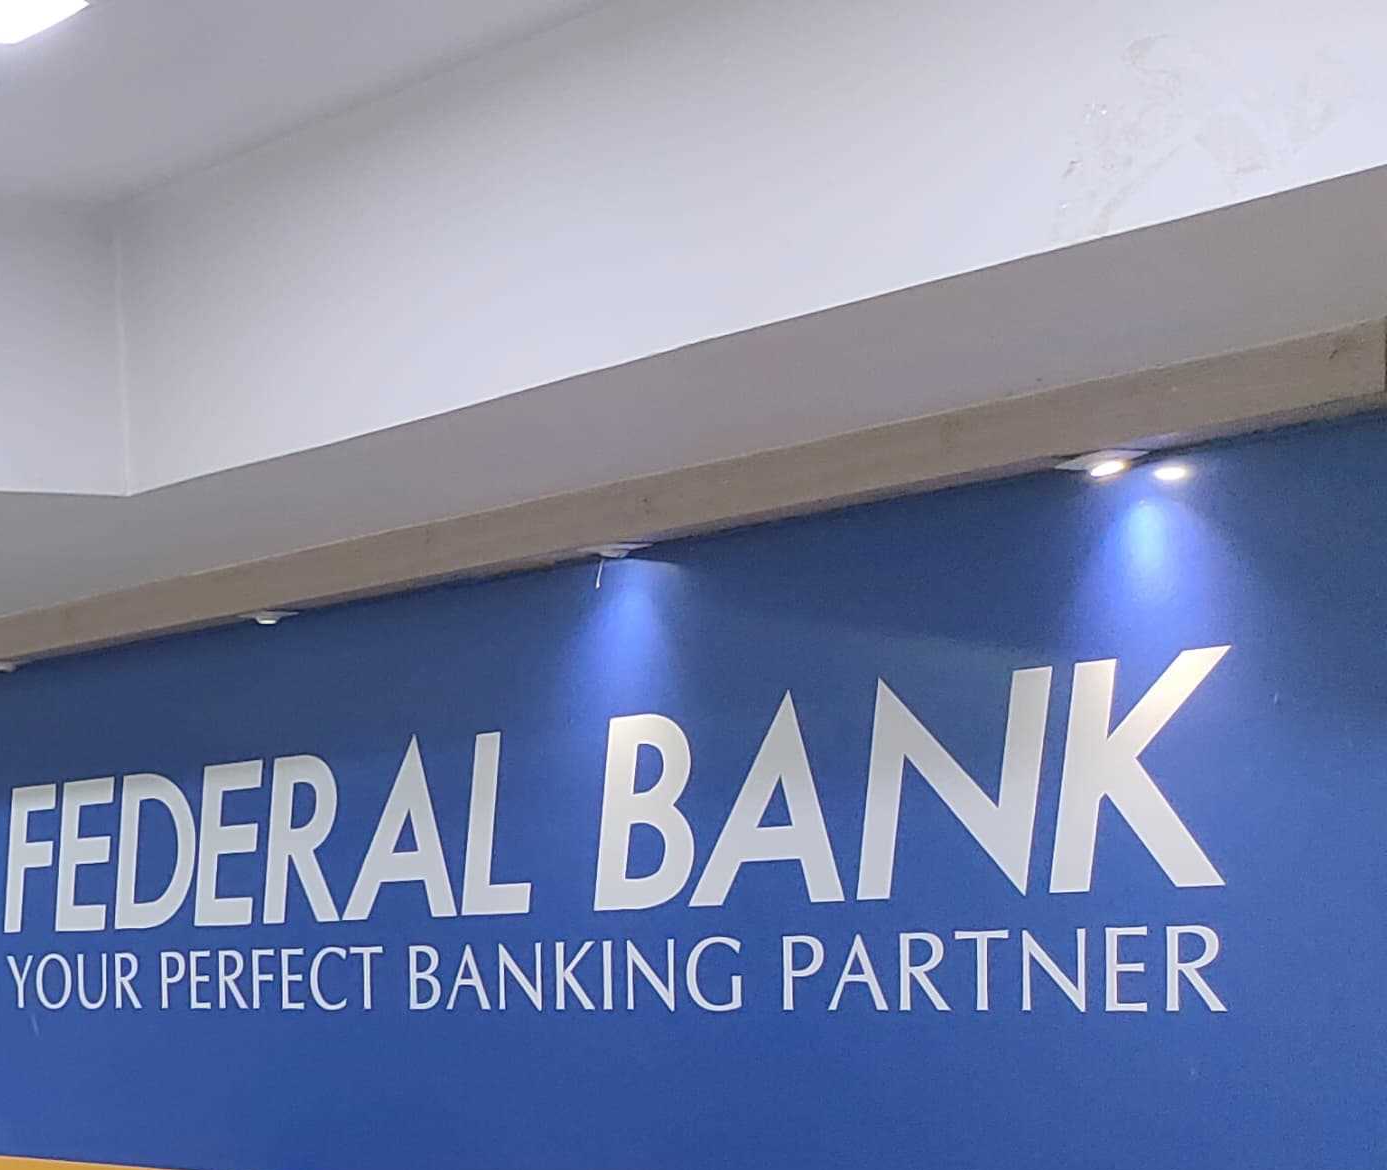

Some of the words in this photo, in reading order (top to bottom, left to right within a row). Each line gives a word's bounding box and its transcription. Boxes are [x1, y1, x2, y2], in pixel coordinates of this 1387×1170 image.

[5, 732, 531, 932] FEDERAL
[594, 645, 1232, 911] BANK
[8, 953, 141, 1009] YOUR
[161, 947, 382, 1010] PERFECT
[409, 937, 741, 1011] BANKING
[783, 925, 1227, 1012] PARTNER
